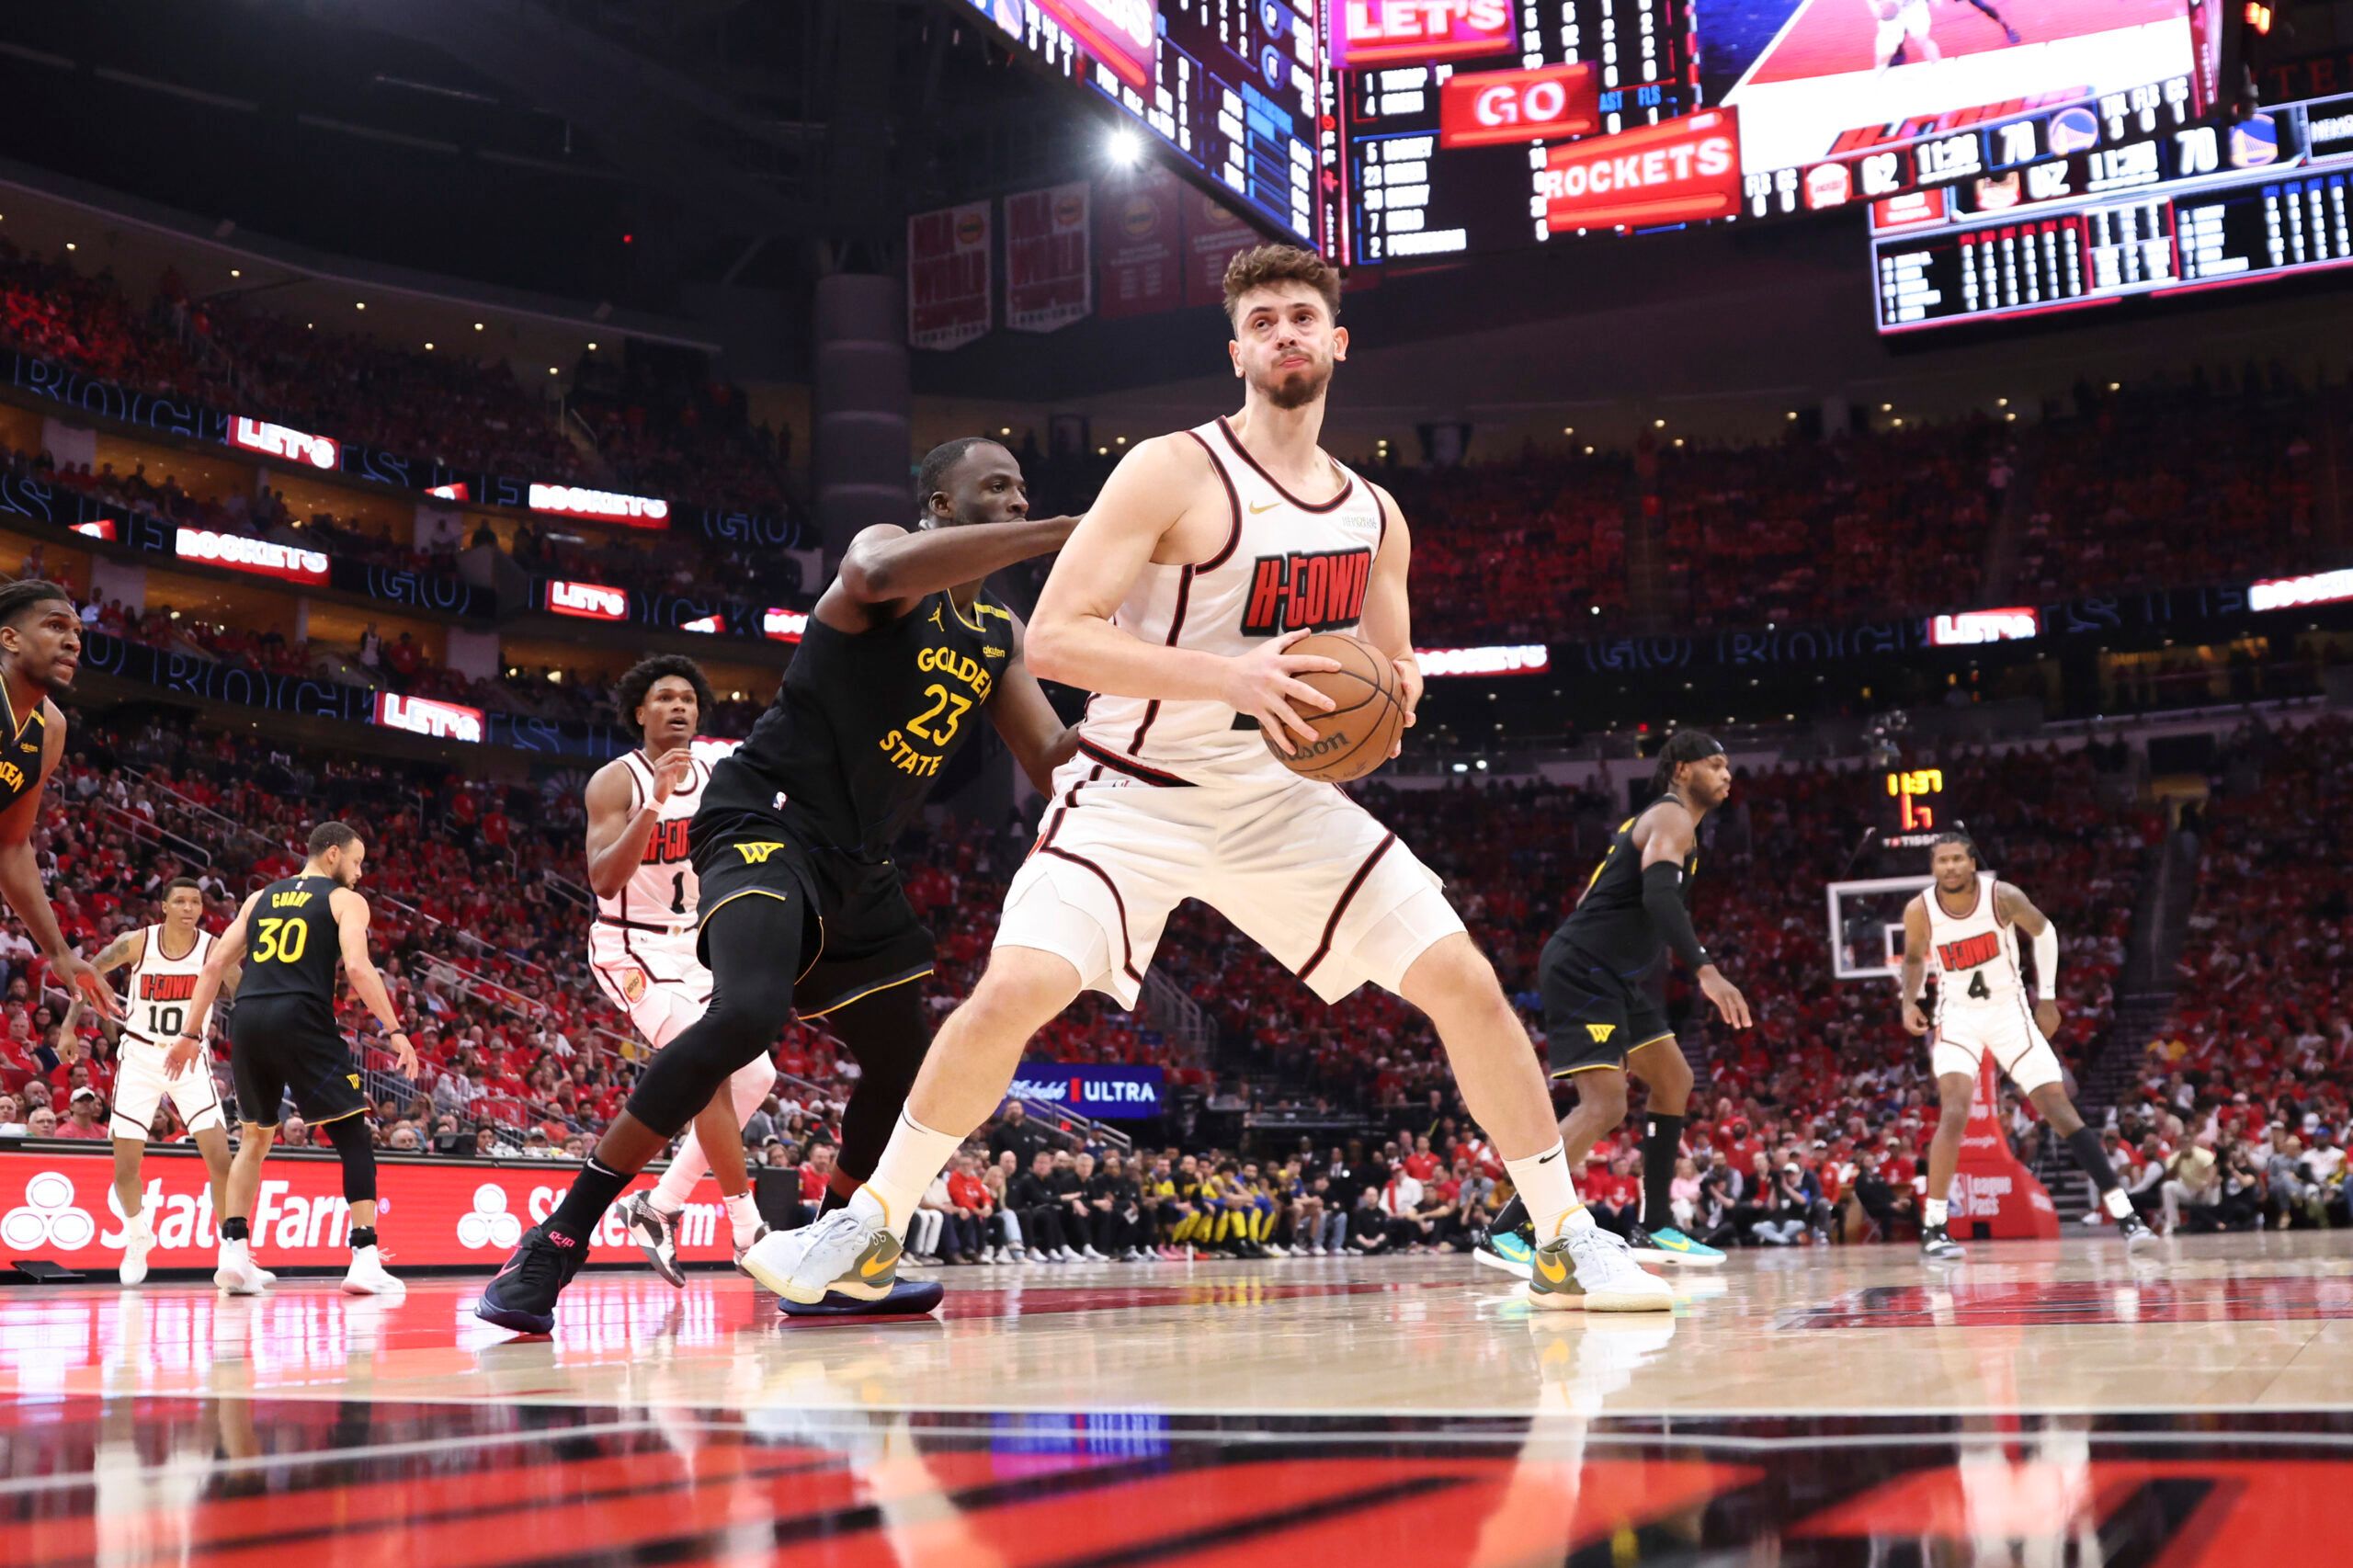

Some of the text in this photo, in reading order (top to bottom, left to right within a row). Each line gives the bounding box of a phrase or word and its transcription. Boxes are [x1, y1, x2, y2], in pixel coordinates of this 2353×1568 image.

[1347, 0, 1506, 40] LET'S
[1475, 81, 1566, 126] GO
[1598, 85, 1662, 113] AST FLS
[1542, 137, 1733, 200] ROCKETS
[2175, 127, 2219, 176] 70
[237, 415, 335, 470] LET'S
[529, 483, 668, 519] ROCKETS
[176, 527, 329, 574] ROCKETS
[551, 580, 625, 617] LET'S
[1934, 613, 2037, 646] LET'S
[916, 646, 993, 707] GOLDEN
[383, 691, 481, 744] LET'S
[905, 683, 972, 747] 23
[879, 730, 943, 777] STATE
[272, 891, 313, 909] CURRY
[670, 870, 688, 915] 1
[252, 917, 308, 964] 30
[1967, 970, 1991, 1001] 4
[147, 1004, 184, 1037] 10
[1084, 1081, 1155, 1102] ULTRA
